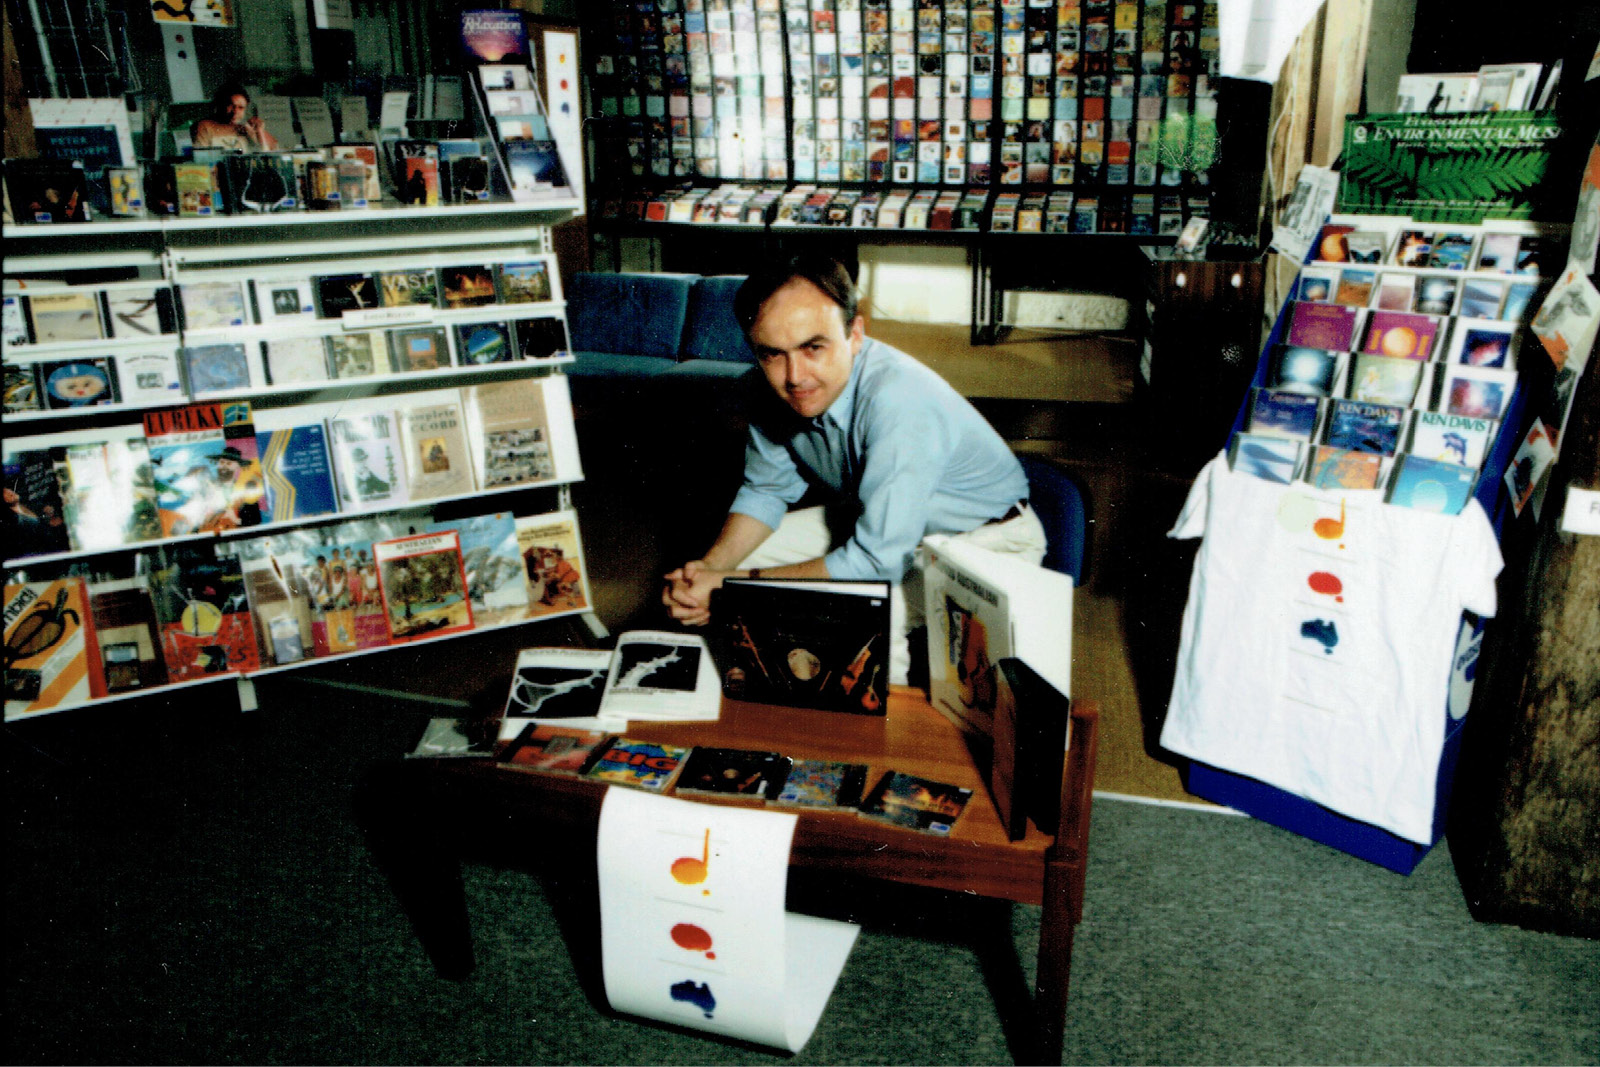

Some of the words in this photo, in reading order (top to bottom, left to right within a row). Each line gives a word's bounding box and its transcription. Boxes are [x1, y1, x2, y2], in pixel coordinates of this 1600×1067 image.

[382, 274, 431, 290] VAST
[1338, 403, 1363, 414] KEN
[146, 404, 221, 434] EUREKA
[1422, 412, 1447, 427] KEN
[1449, 416, 1486, 432] DAVIS
[602, 748, 681, 771] BIG
